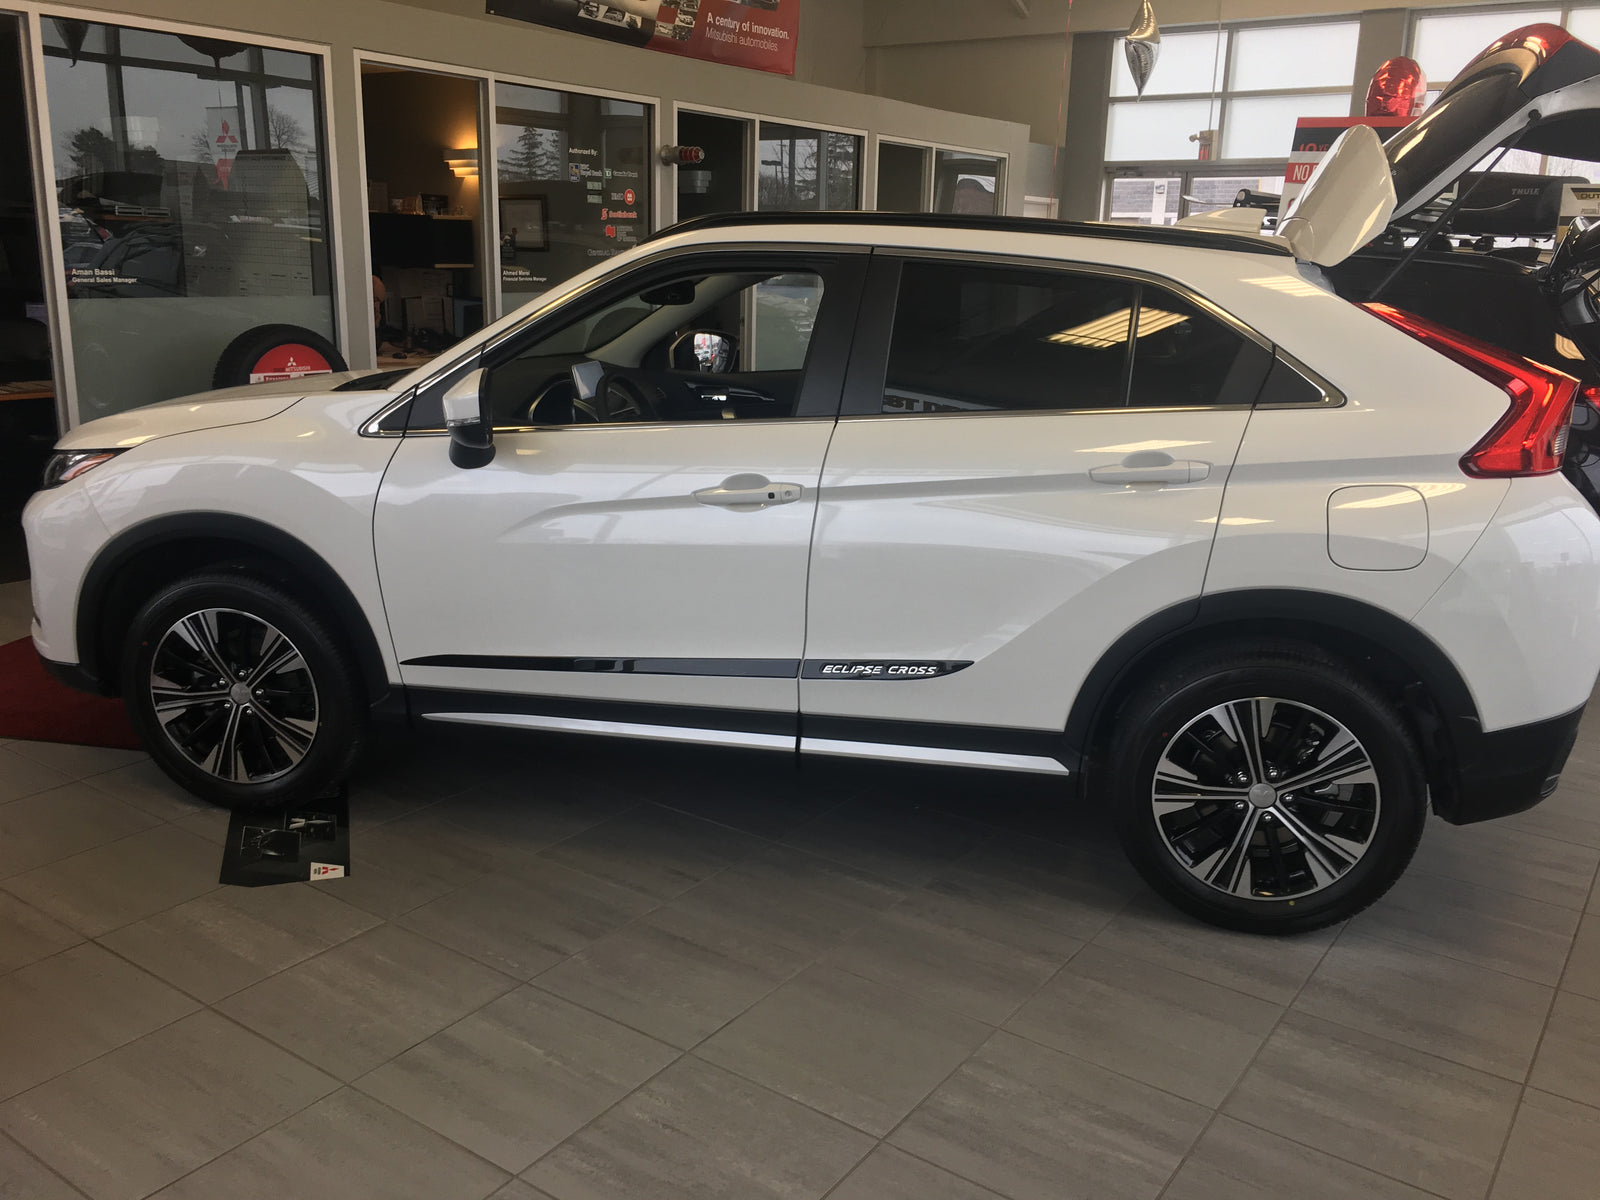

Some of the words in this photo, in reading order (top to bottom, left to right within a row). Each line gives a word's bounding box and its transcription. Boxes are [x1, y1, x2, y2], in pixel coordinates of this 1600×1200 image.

[707, 12, 714, 24] A
[715, 16, 740, 32] century
[742, 21, 750, 32] of
[752, 22, 790, 40] innovation.
[705, 27, 738, 44] Mitsubishi
[739, 36, 779, 52] automobiles
[1293, 165, 1309, 180] NO
[94, 268, 116, 276] Bassi
[822, 665, 883, 675] ECLIPSE
[887, 666, 937, 675] CROSS
